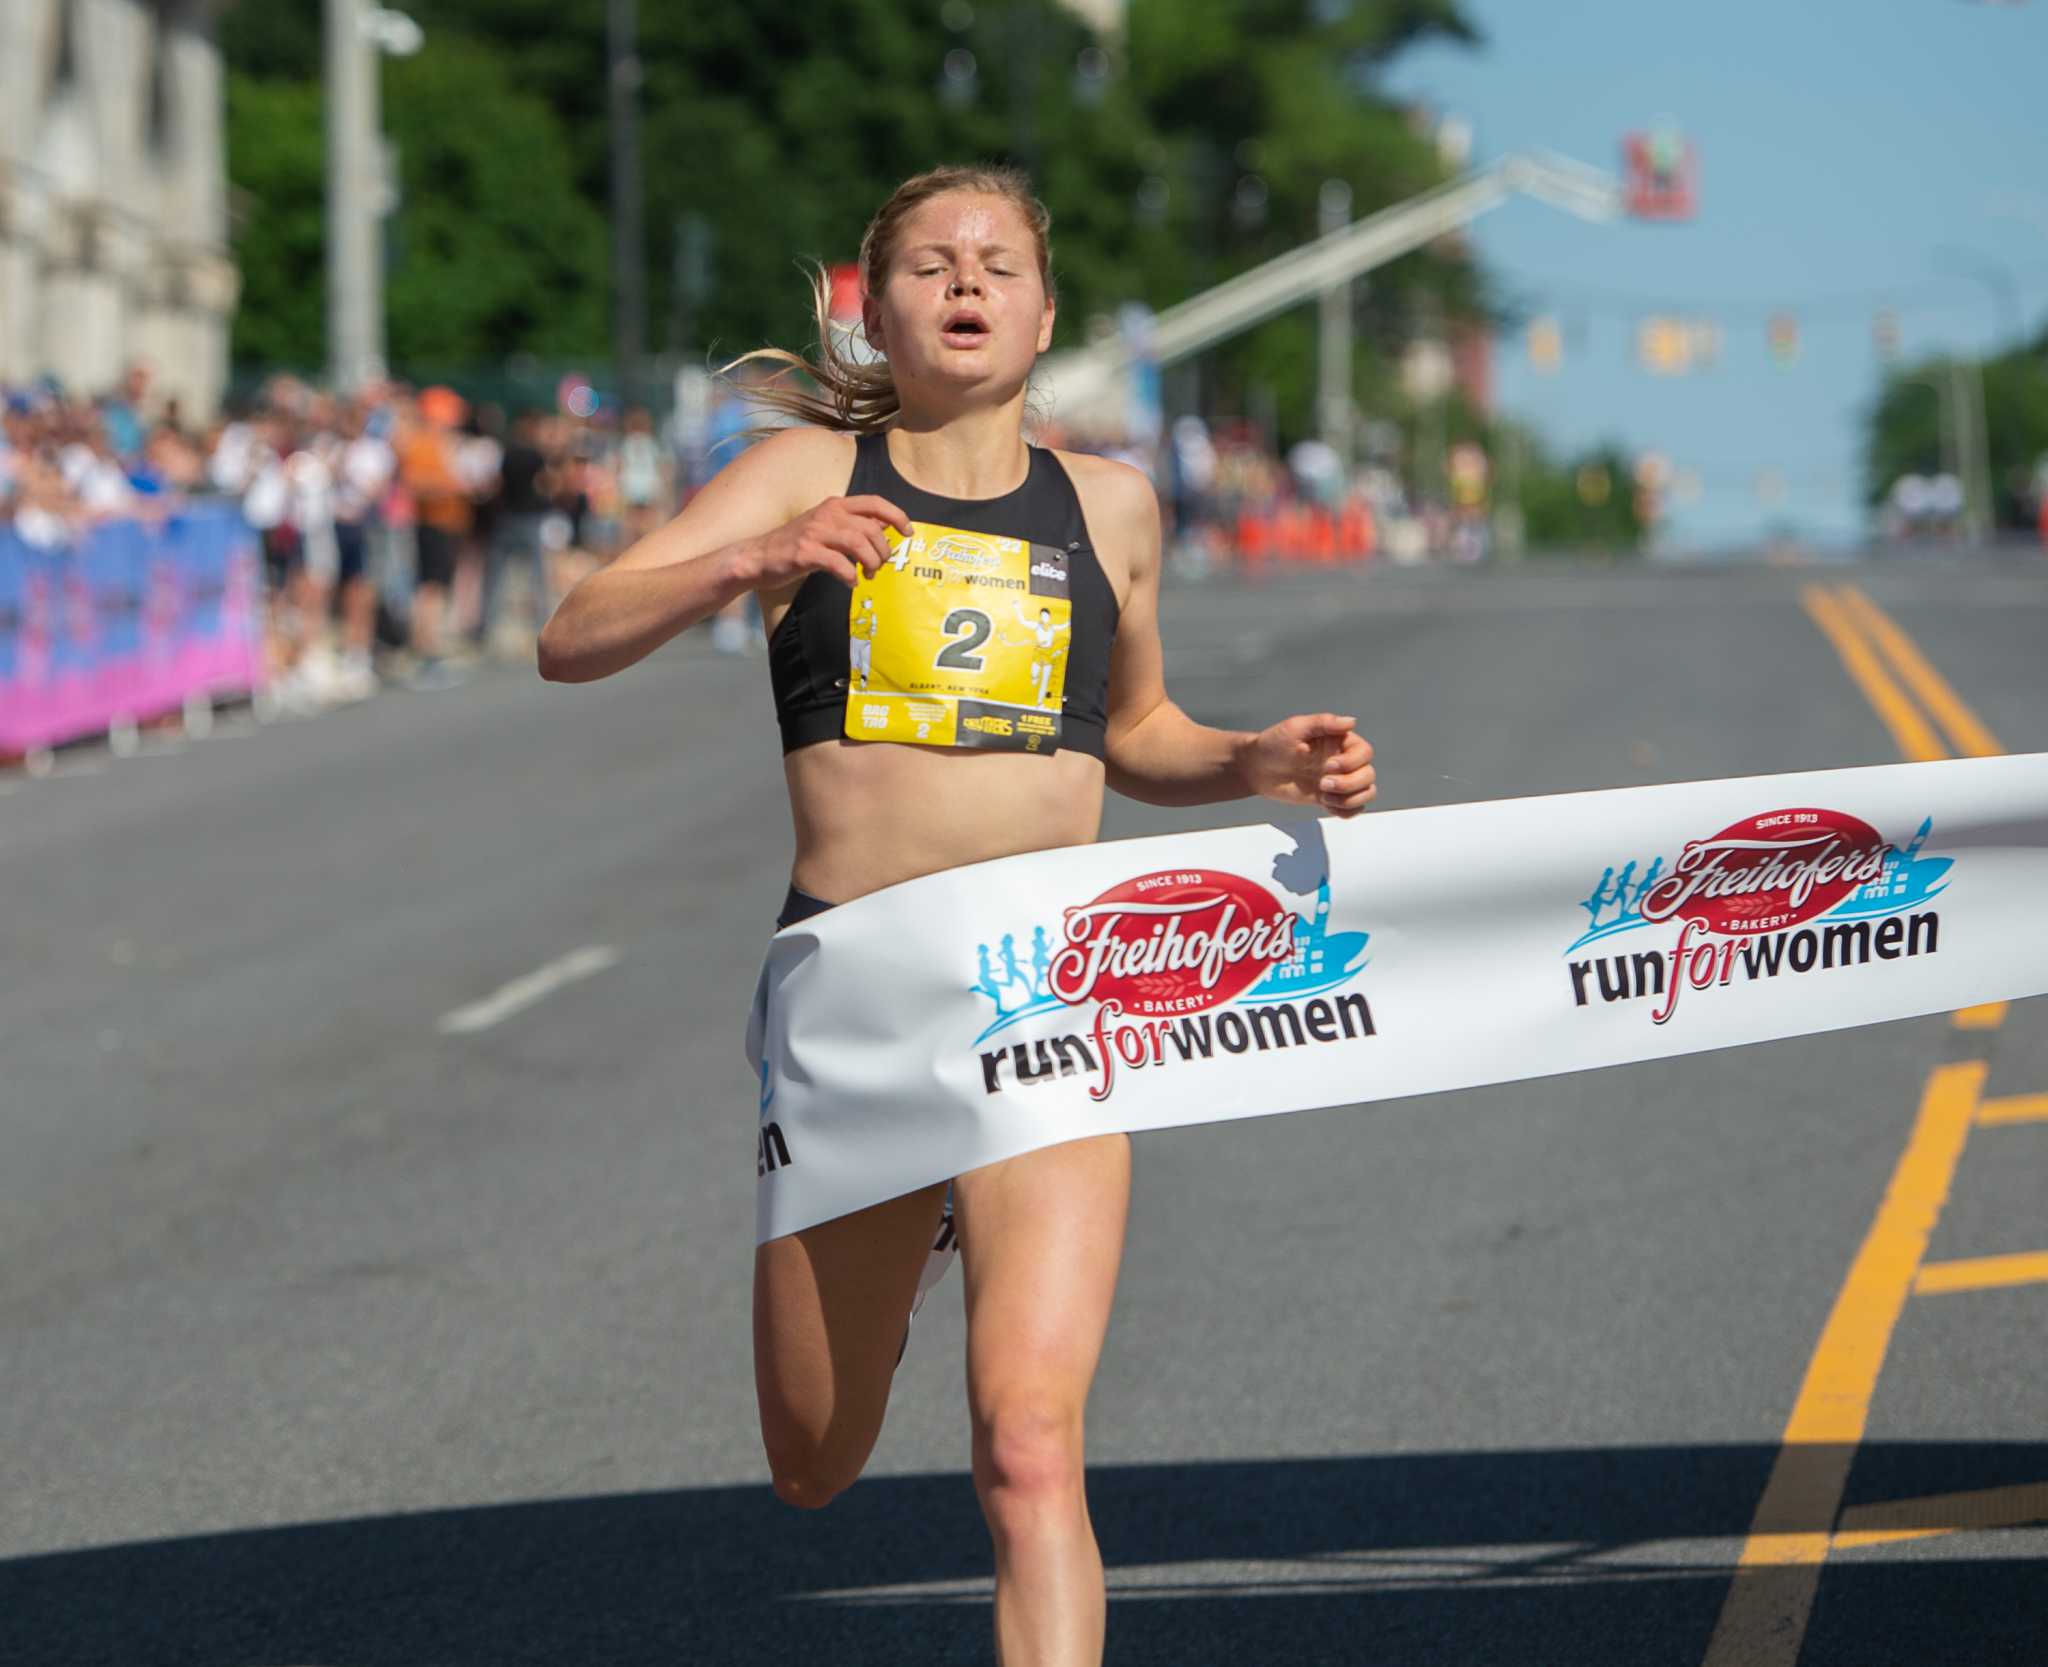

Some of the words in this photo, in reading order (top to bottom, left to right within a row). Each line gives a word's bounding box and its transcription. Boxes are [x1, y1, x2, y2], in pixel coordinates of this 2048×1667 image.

[913, 566, 943, 580] run
[963, 574, 1026, 590] women
[1031, 562, 1067, 582] elite
[934, 608, 992, 671] 2
[1755, 814, 1792, 830] SINCE
[1793, 813, 1819, 824] 1913
[1136, 875, 1173, 892] SINCE
[1176, 873, 1203, 885] 1913
[1642, 831, 1889, 923] Freihofer's
[1729, 913, 1790, 931] BAKERY
[1050, 893, 1296, 1002] Freihofer's
[1143, 994, 1205, 1013] BAKERY
